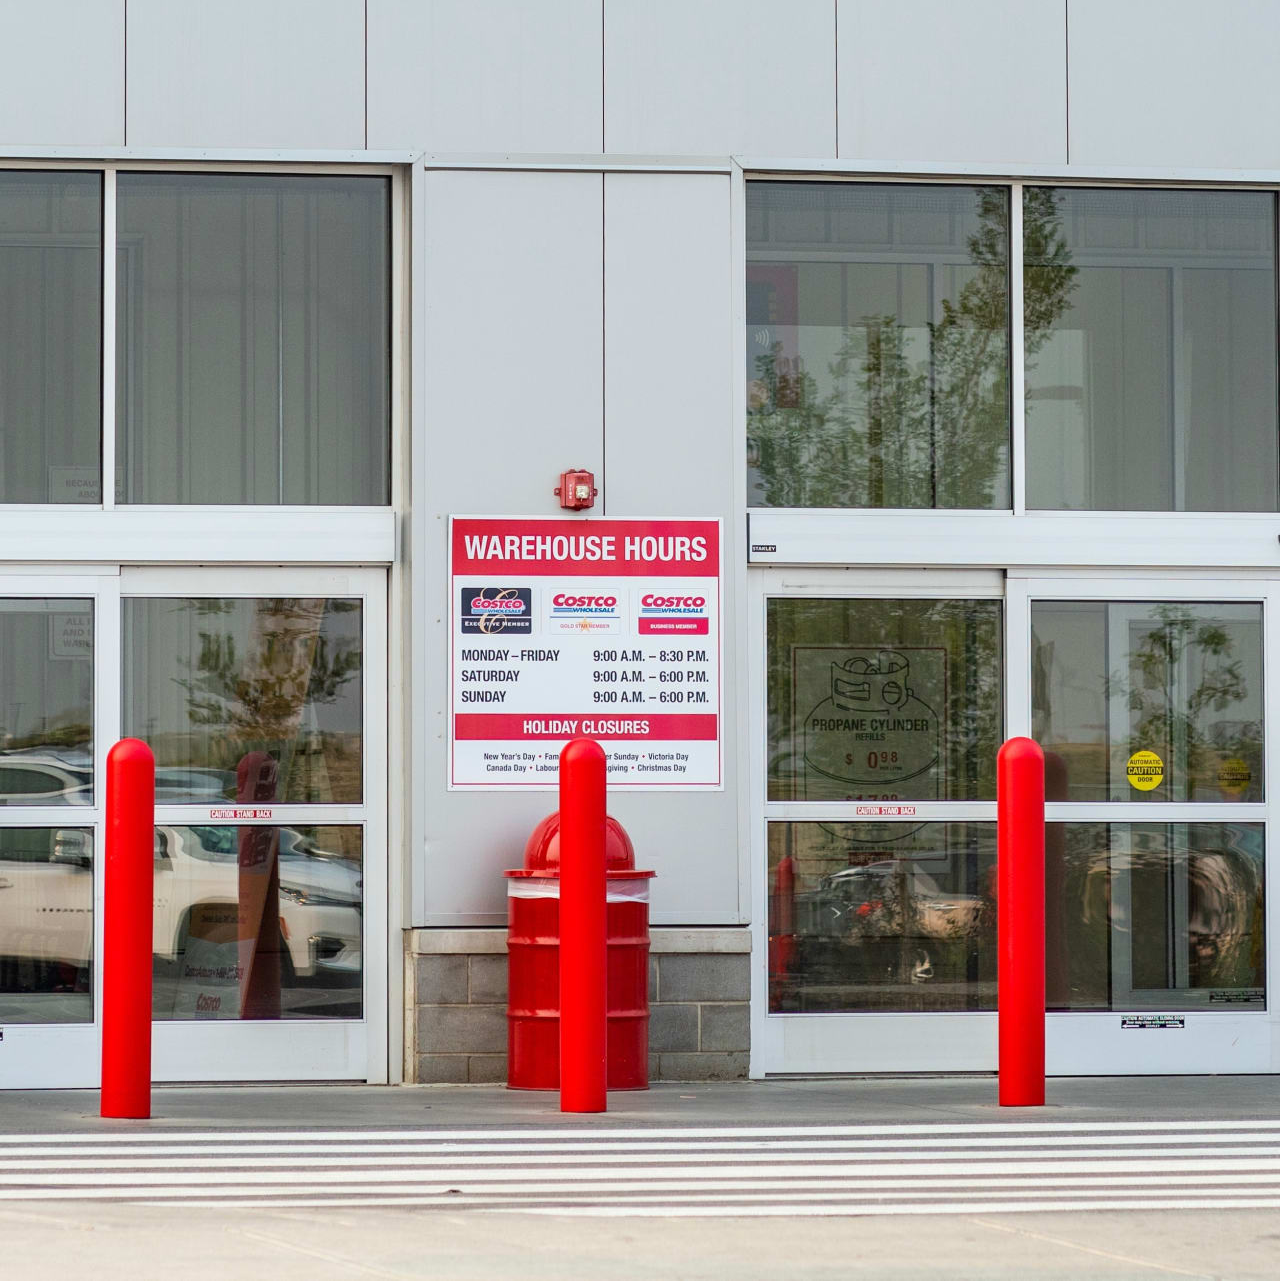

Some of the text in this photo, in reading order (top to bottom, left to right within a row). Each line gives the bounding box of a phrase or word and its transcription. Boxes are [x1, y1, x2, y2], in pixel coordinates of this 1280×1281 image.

[465, 535, 707, 561] WAREHOUSE HOURS
[472, 597, 523, 609] COSTCO
[553, 593, 617, 607] COSTCO
[641, 594, 706, 608] COSTCO
[593, 651, 617, 662] 9:00
[620, 651, 645, 662] A.M.
[659, 651, 683, 662] 8:30
[687, 651, 709, 662] P.M.
[462, 671, 520, 682] SATURDAY
[593, 671, 617, 682] 9:00
[620, 671, 645, 682] A.M.
[659, 671, 683, 682] 6:00
[687, 671, 709, 682] P.M.
[462, 691, 506, 702] SUNDAY
[593, 692, 617, 703] 9:00
[620, 692, 645, 703] A.M.
[659, 692, 683, 703] 6:00
[687, 692, 709, 703] P.M.
[523, 720, 649, 734] HOLIDAY CLOSURES
[812, 719, 929, 731] PROPANE CYLINDER
[855, 733, 886, 741] REFILLS
[523, 753, 535, 761] Day
[614, 753, 639, 761] Sunday
[676, 753, 688, 761] Day
[514, 764, 526, 772] Day
[674, 764, 686, 772] Day
[212, 810, 271, 818] CAUTION STAND BACK
[858, 807, 915, 815] CAUTION STAND BACK
